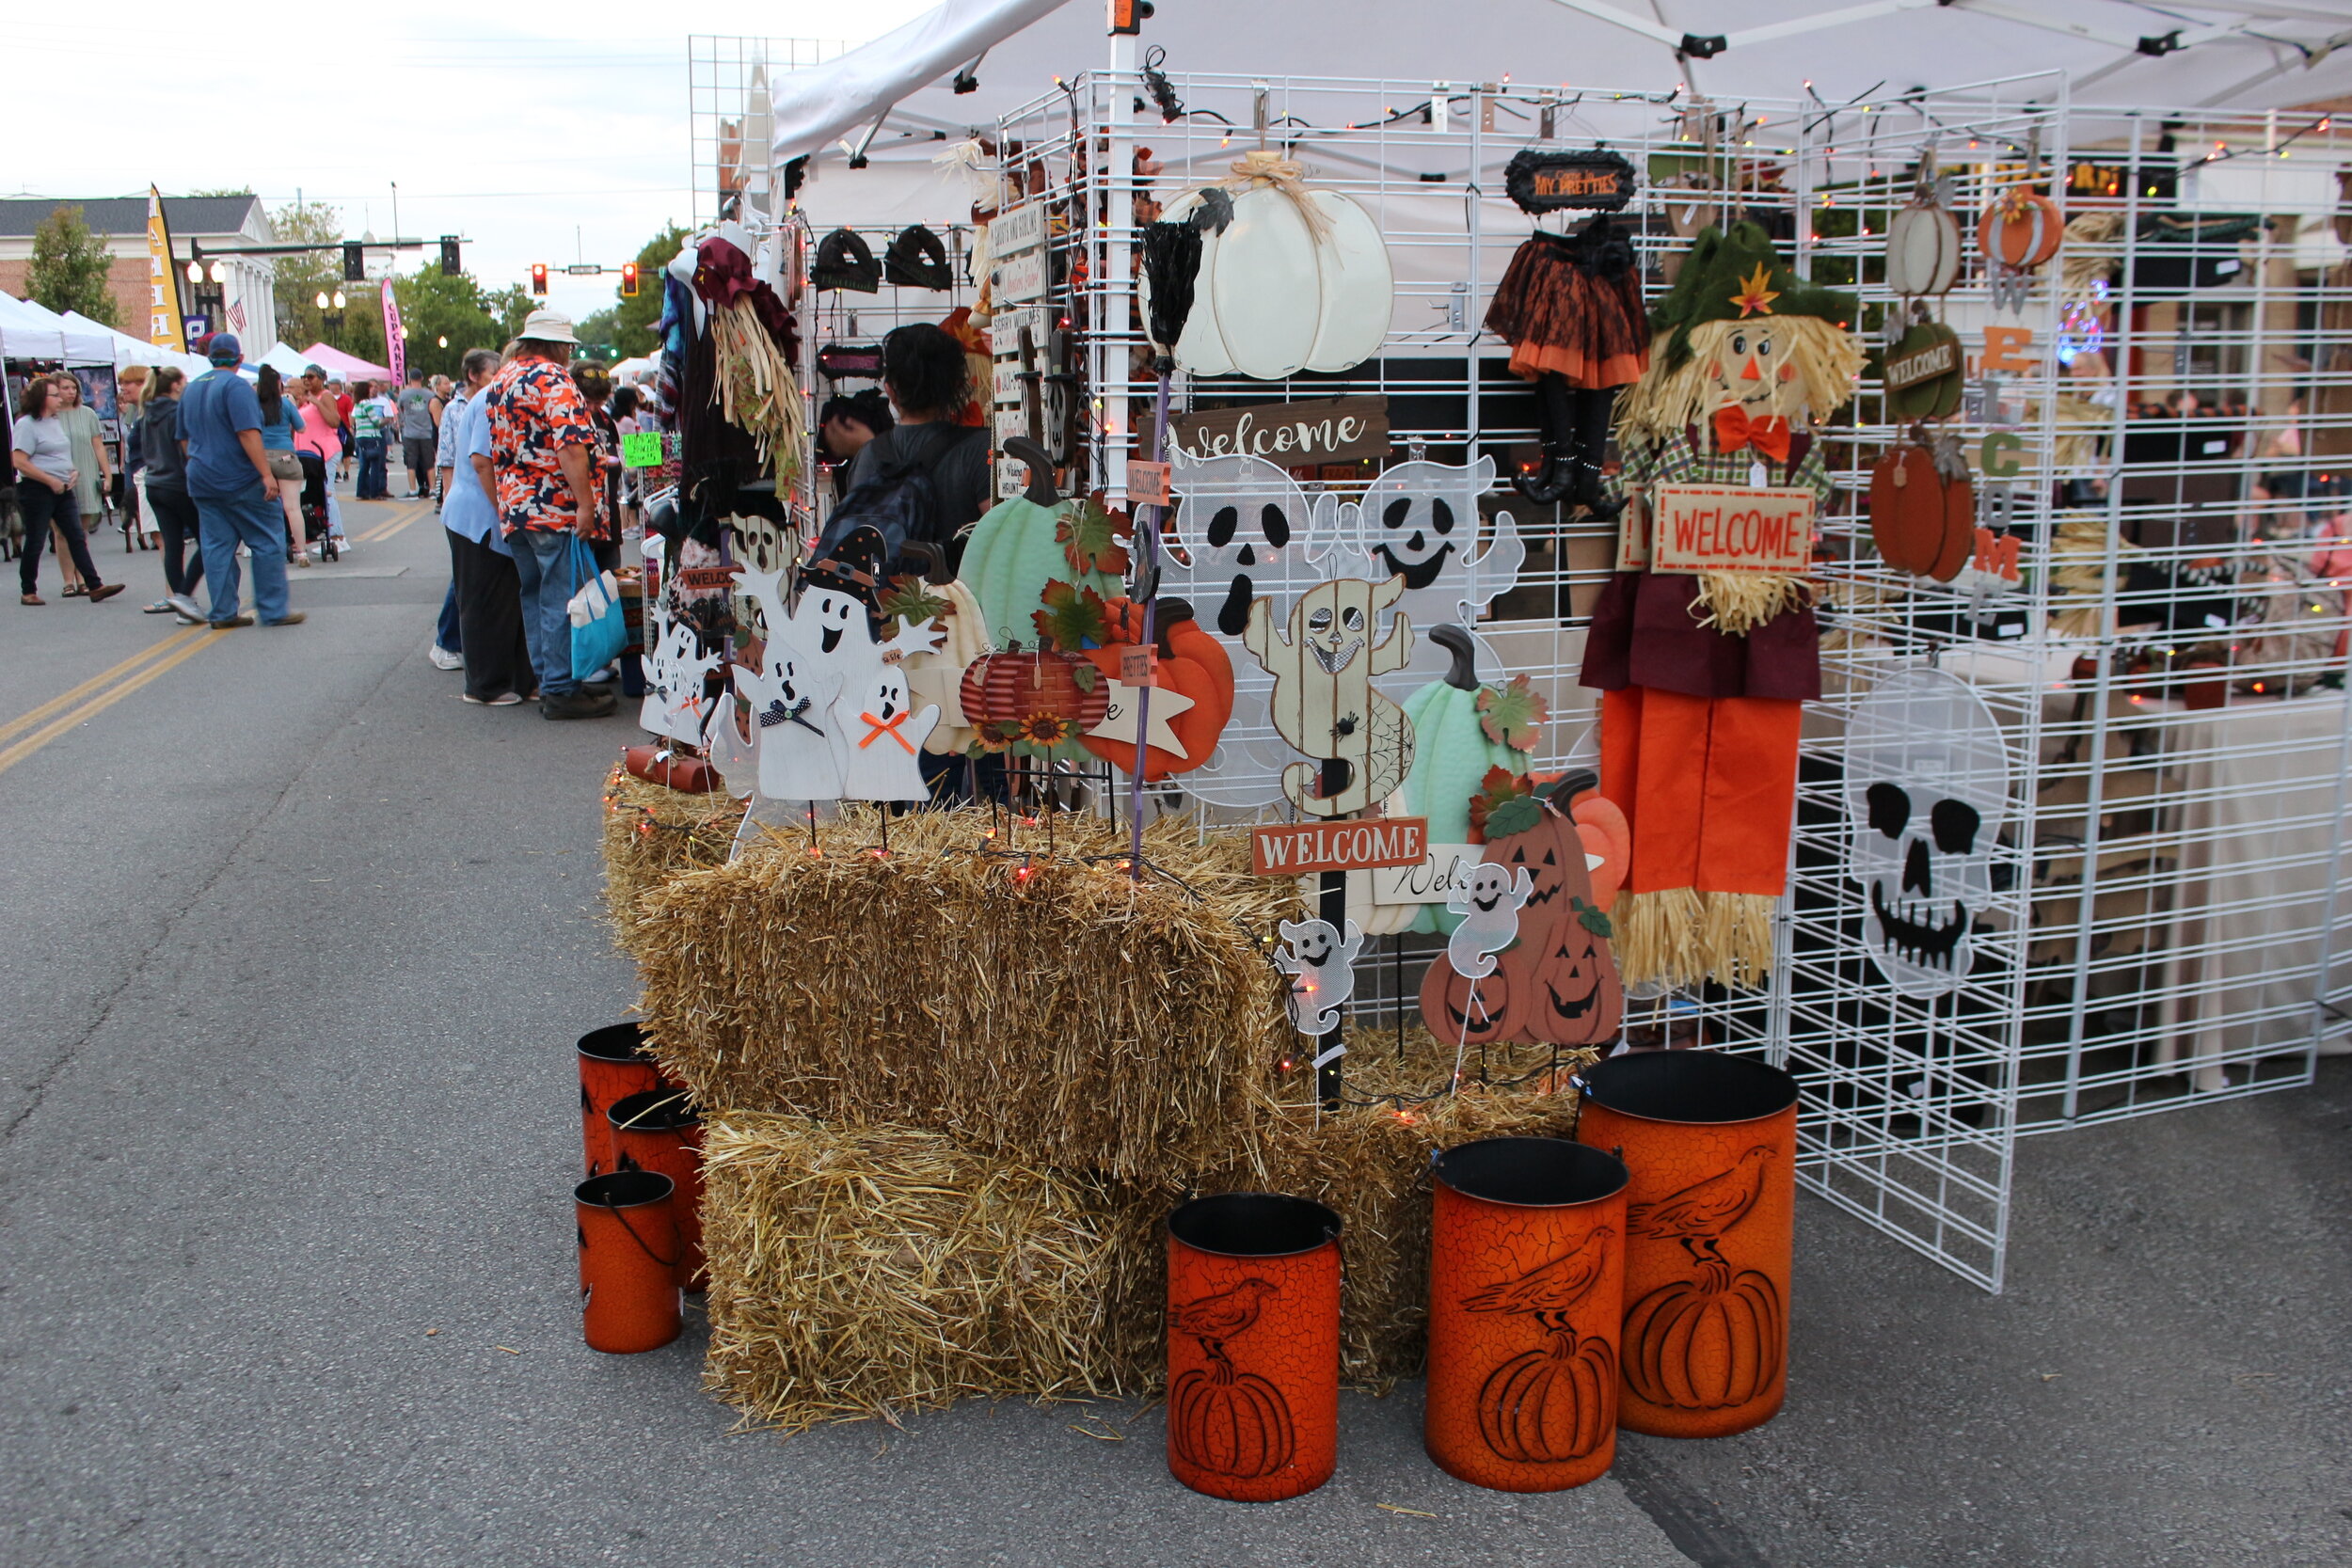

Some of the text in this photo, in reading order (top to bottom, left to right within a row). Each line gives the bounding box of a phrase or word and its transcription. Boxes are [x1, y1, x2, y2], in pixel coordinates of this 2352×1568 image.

[1534, 173, 1618, 196] MY PRETTIES
[389, 302, 403, 382] CUPCAKES
[1886, 343, 1952, 388] WELCOME
[1129, 468, 1161, 497] WELCOME
[1675, 507, 1803, 560] WELCOME
[1122, 654, 1148, 677] PRETTIES
[1259, 826, 1420, 869] WELCOME
